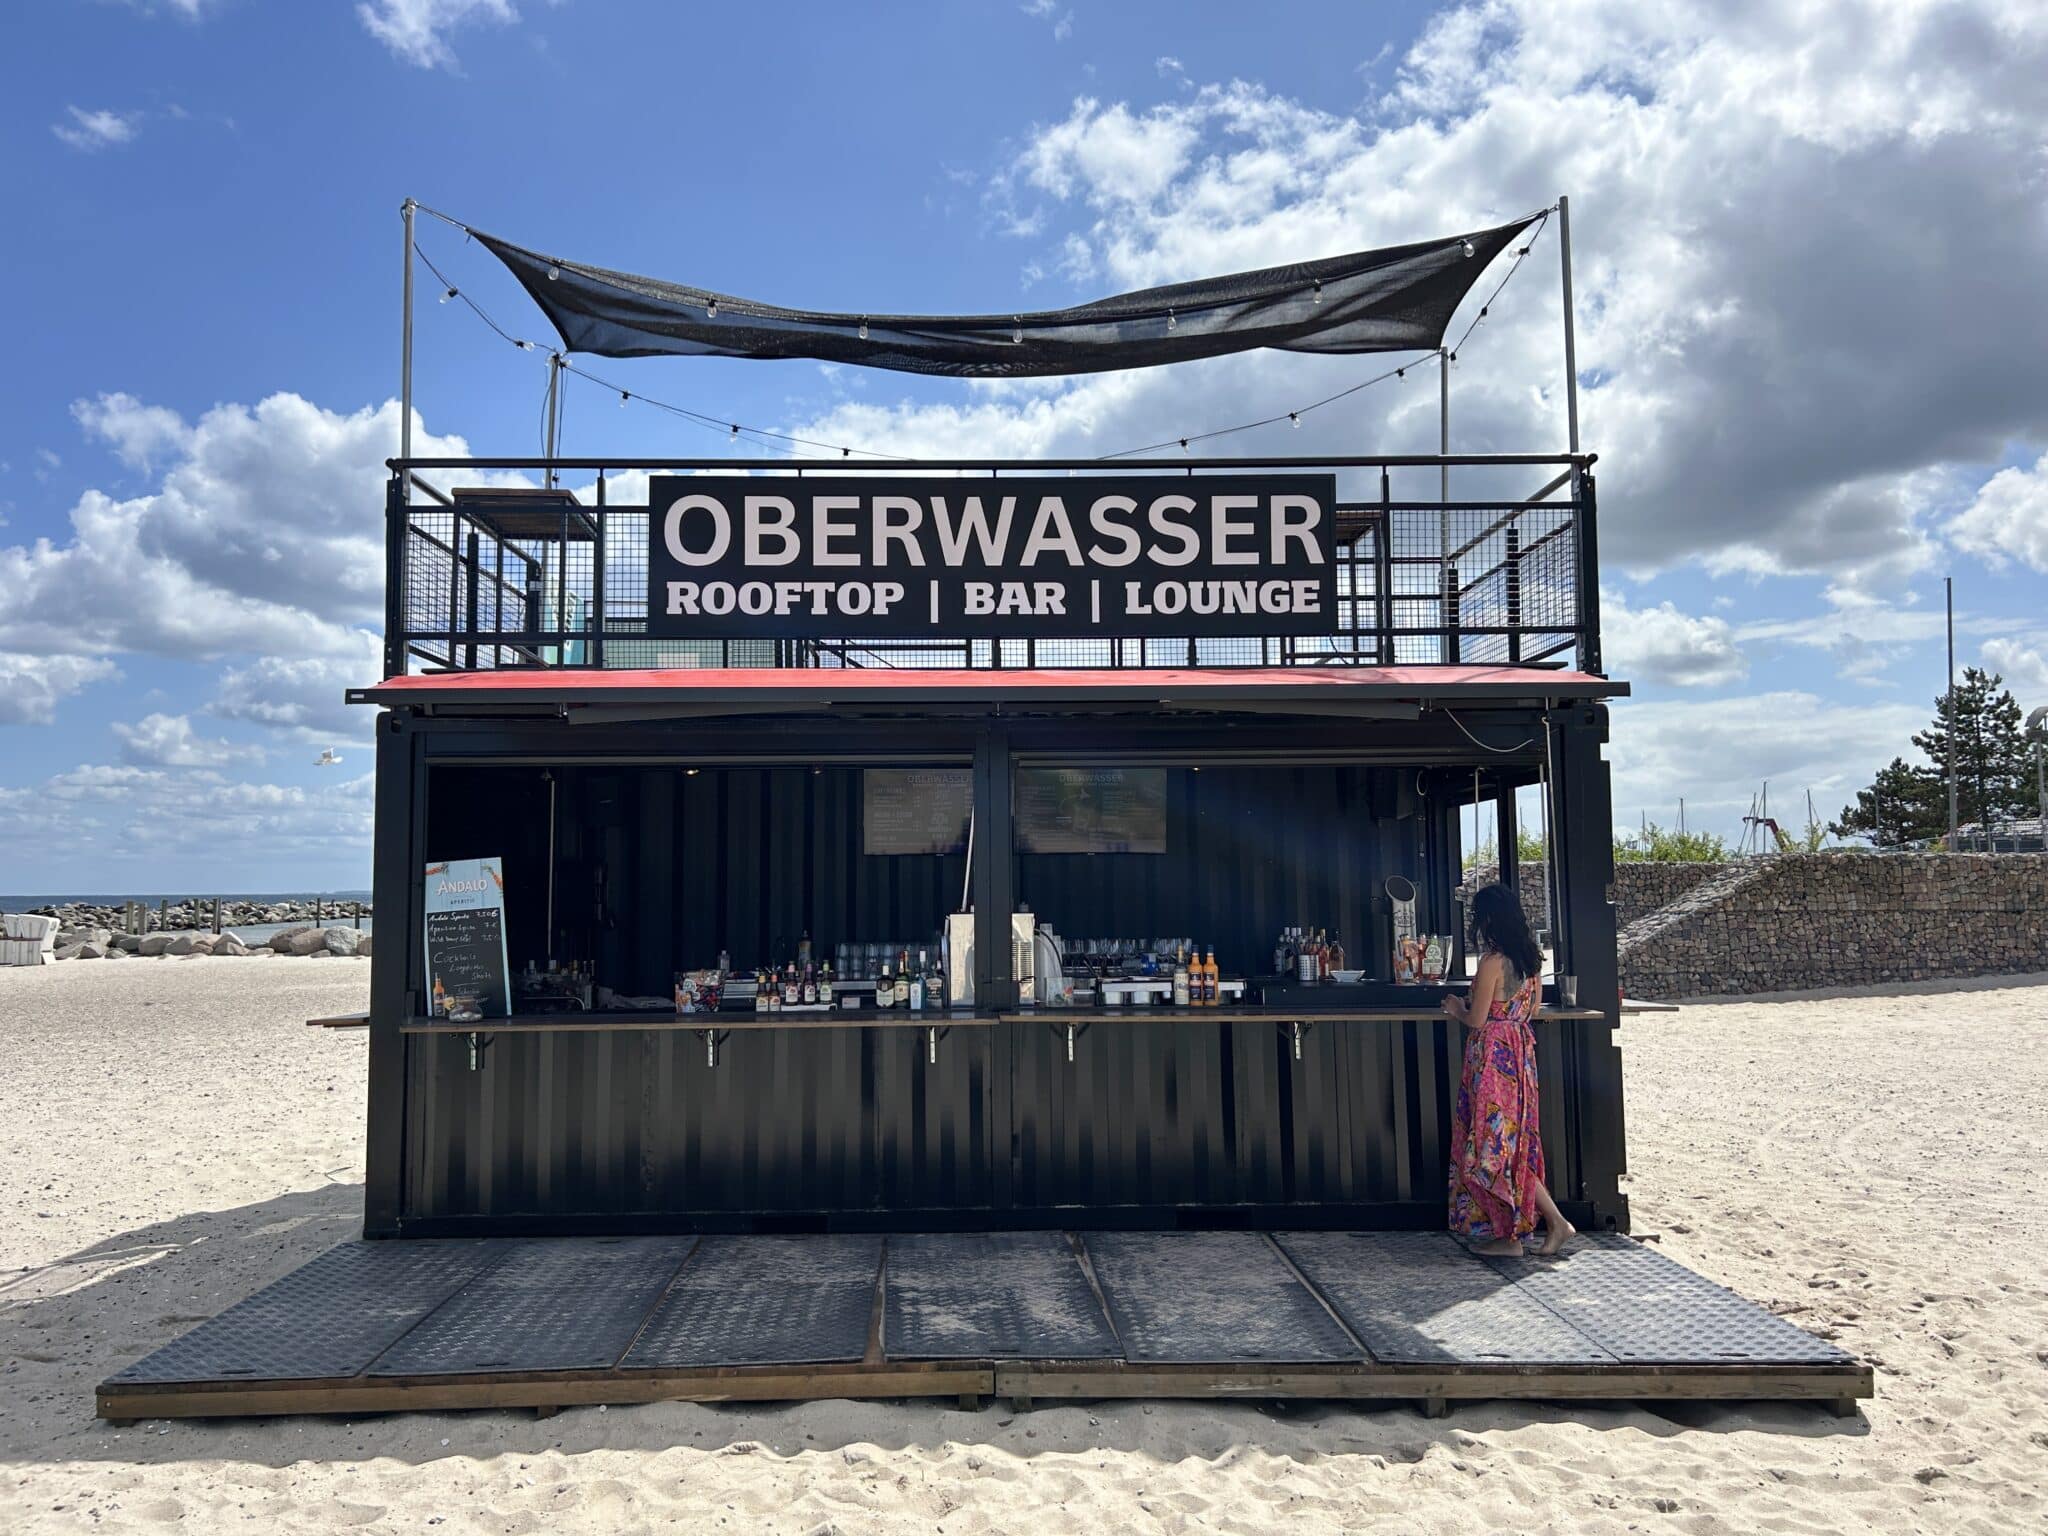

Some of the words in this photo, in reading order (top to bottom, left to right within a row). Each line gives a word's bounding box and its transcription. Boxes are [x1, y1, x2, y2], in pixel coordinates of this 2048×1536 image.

[663, 494, 1325, 567] OBERWASSER
[666, 580, 905, 616] ROOFTOP
[963, 581, 1067, 616] BAR
[1125, 580, 1321, 615] LOUNGE
[437, 880, 487, 895] ANDALO
